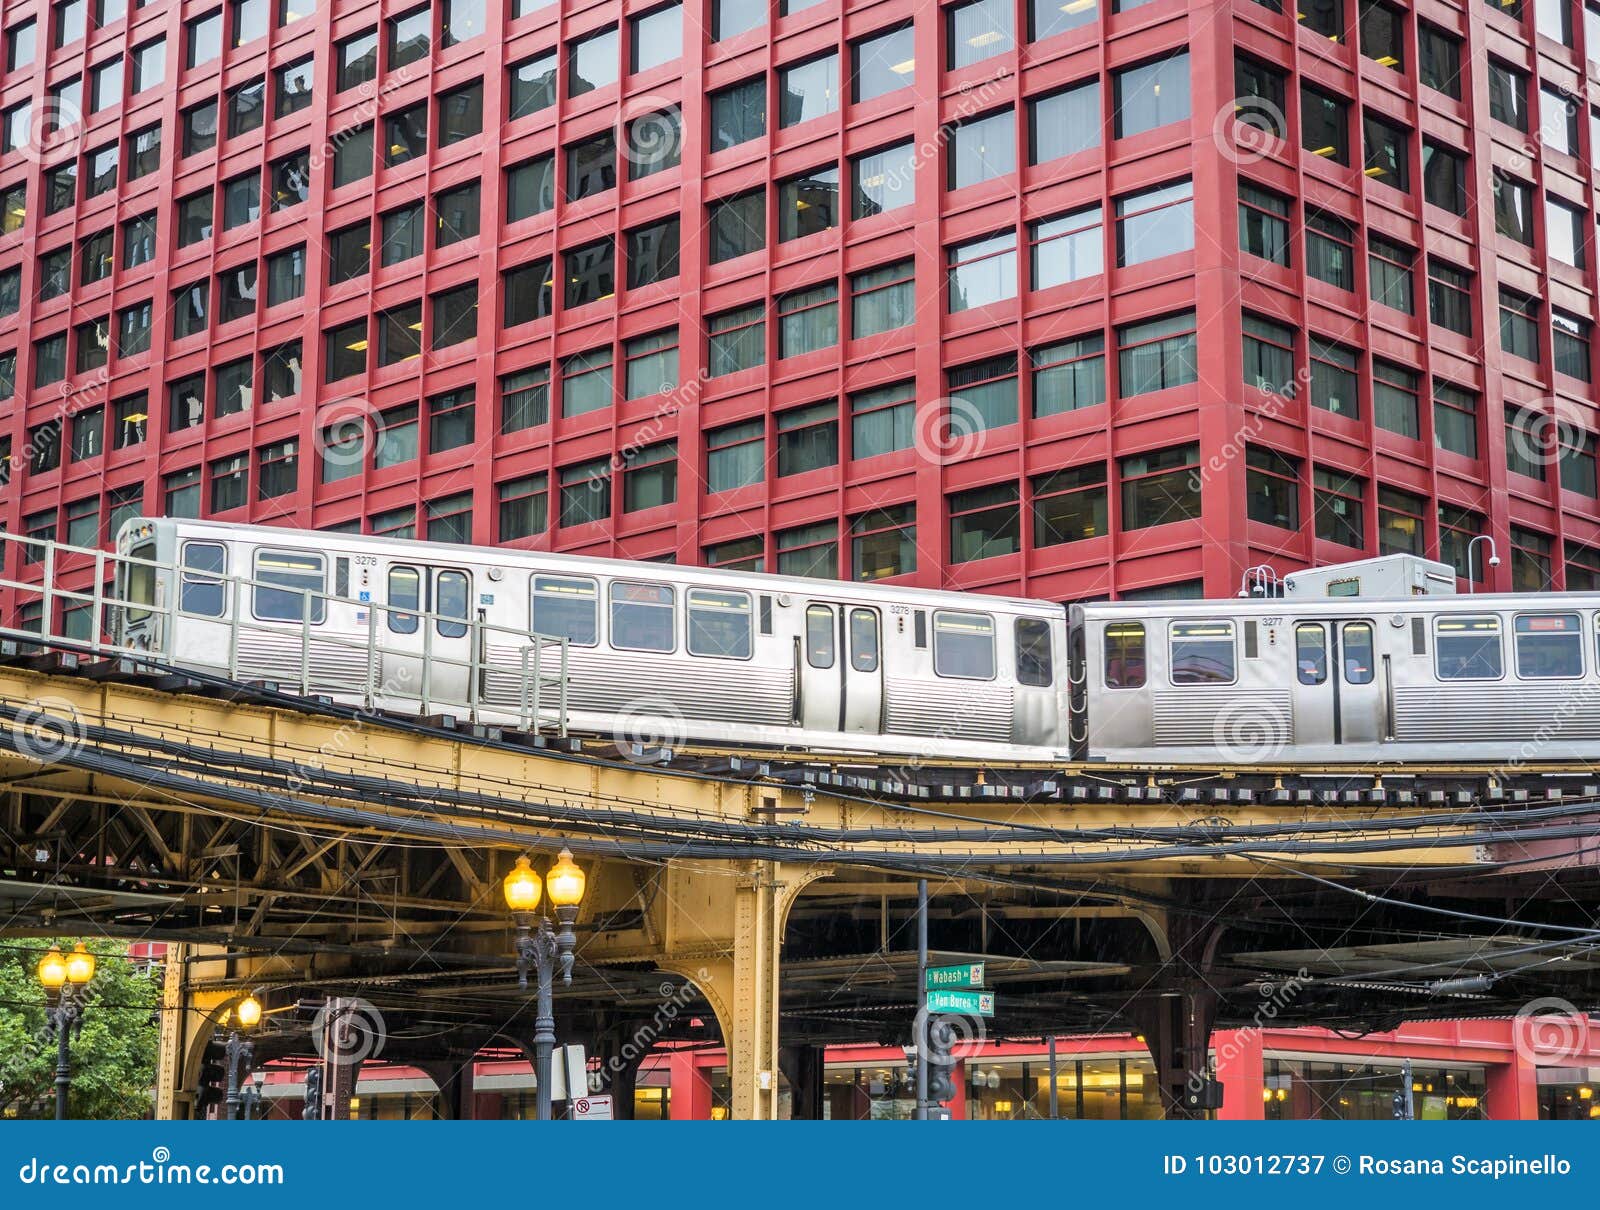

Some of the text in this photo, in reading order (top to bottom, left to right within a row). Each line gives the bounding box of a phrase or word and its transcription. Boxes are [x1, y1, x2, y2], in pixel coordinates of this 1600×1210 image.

[354, 555, 377, 566] 3278
[1262, 617, 1283, 626] 3277
[933, 969, 962, 984] Wabash
[935, 993, 949, 1007] Van
[950, 994, 972, 1009] Buren
